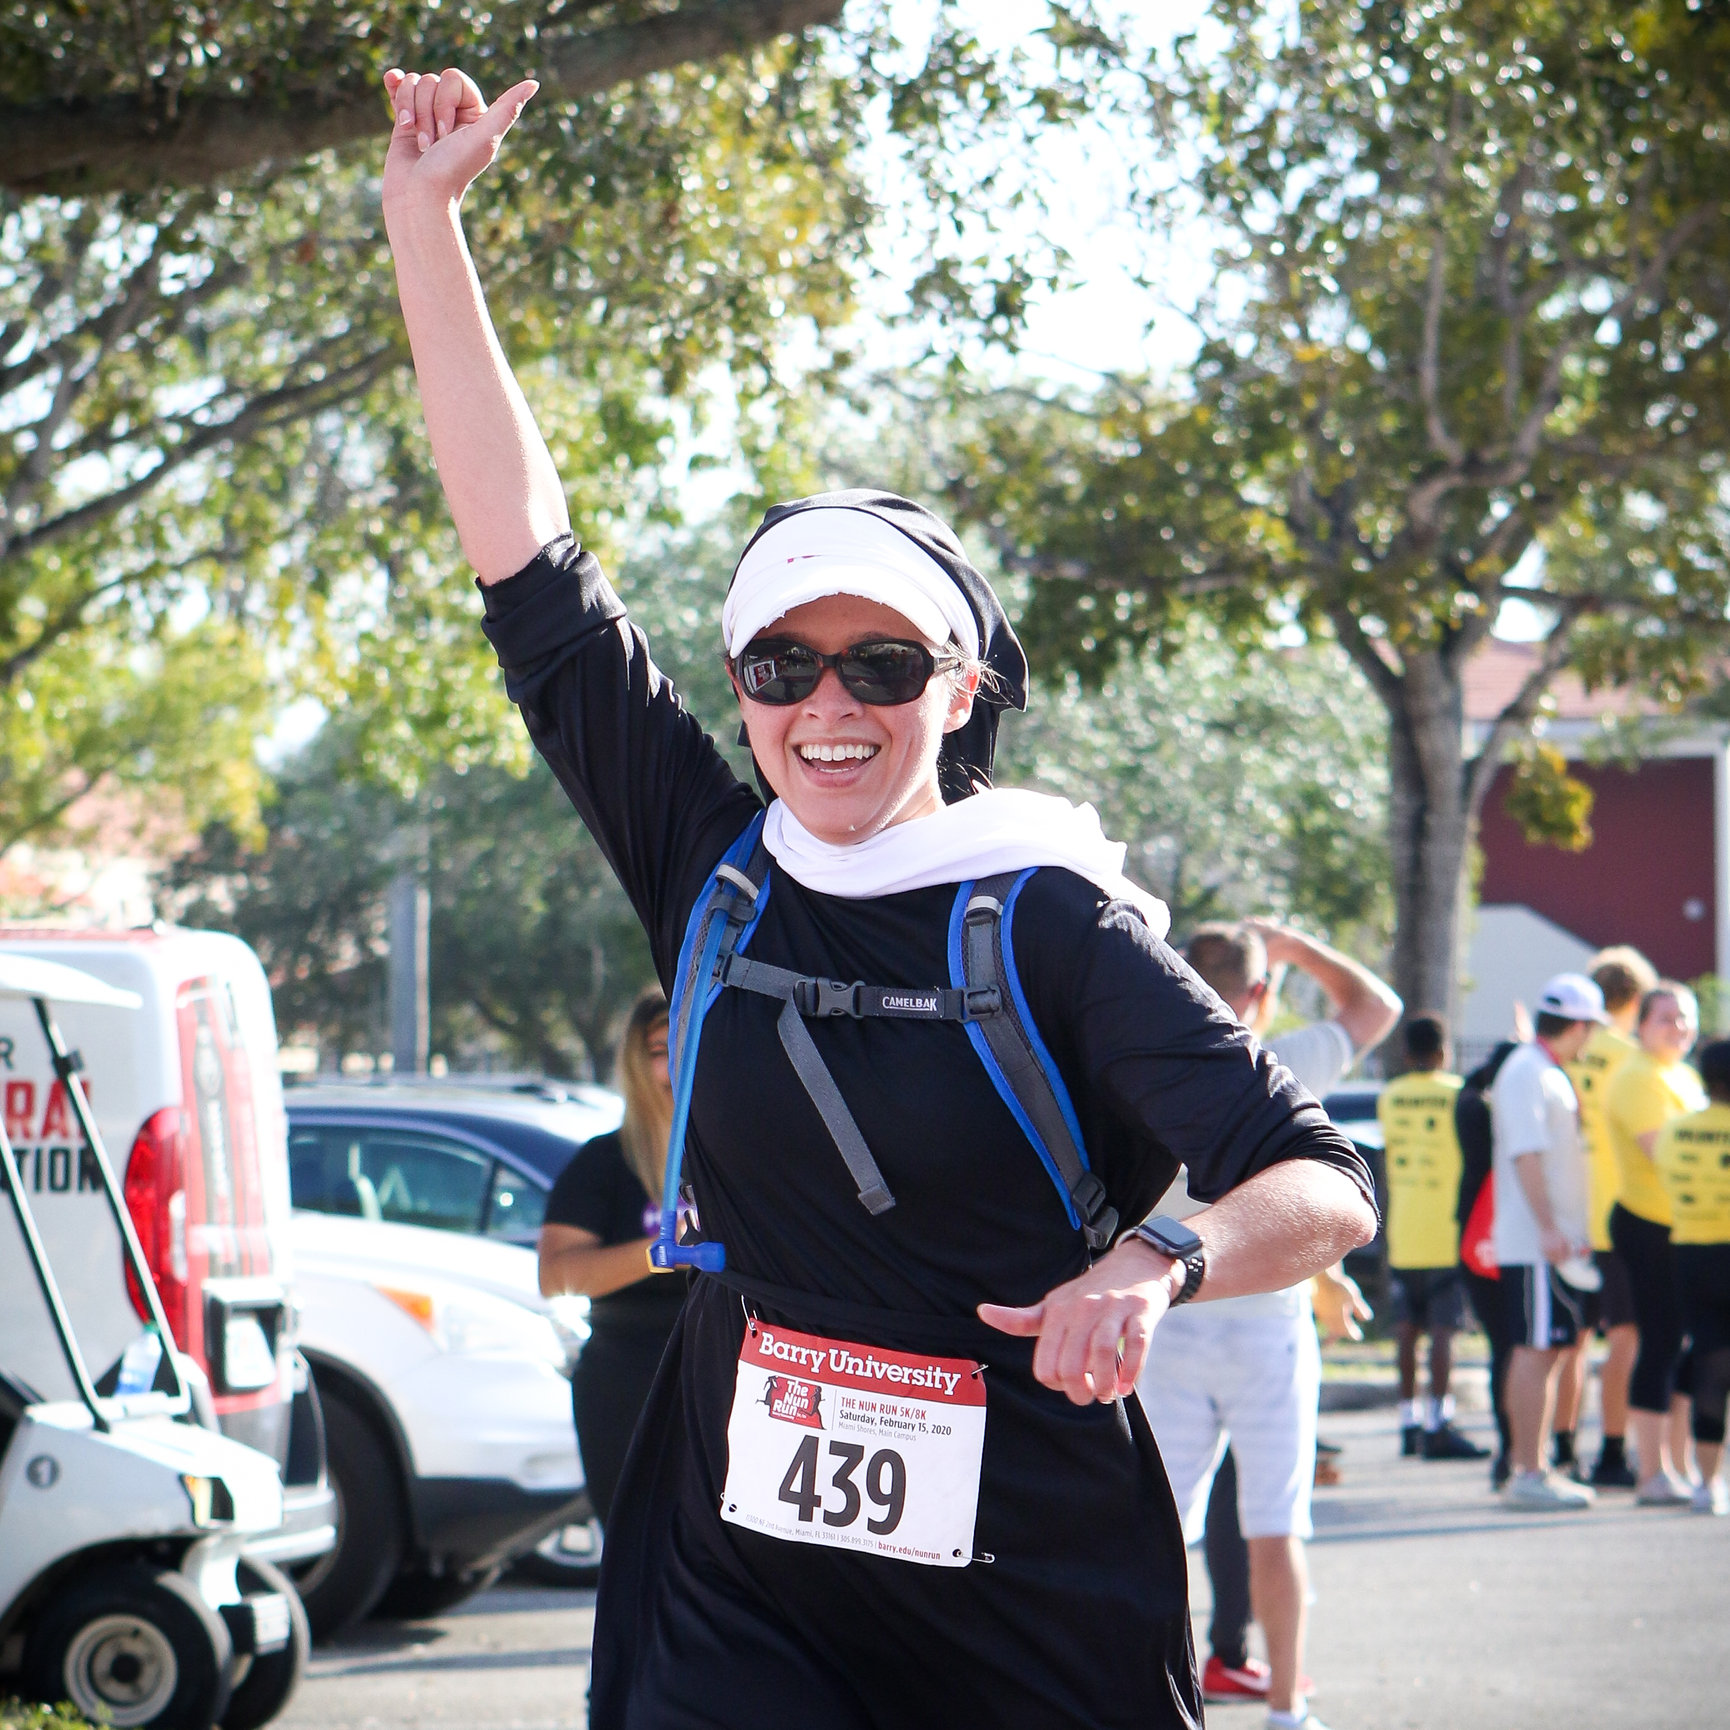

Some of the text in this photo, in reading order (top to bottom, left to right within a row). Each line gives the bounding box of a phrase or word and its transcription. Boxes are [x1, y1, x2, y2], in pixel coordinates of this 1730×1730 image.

[882, 996, 937, 1011] CAMELBAK
[0, 1147, 104, 1193] TION
[759, 1332, 961, 1395] Barry University
[787, 1380, 808, 1397] The
[772, 1399, 797, 1416] Run
[783, 1392, 809, 1409] Nun
[841, 1396, 927, 1420] THE NUN RUN 5K/8K
[838, 1421, 855, 1431] Miami
[879, 1428, 893, 1438] Main
[894, 1431, 917, 1442] Campus
[839, 1409, 952, 1436] Saturday, February 15, 2020
[778, 1434, 906, 1536] 439
[877, 1541, 941, 1560] barry.edu/nunrun
